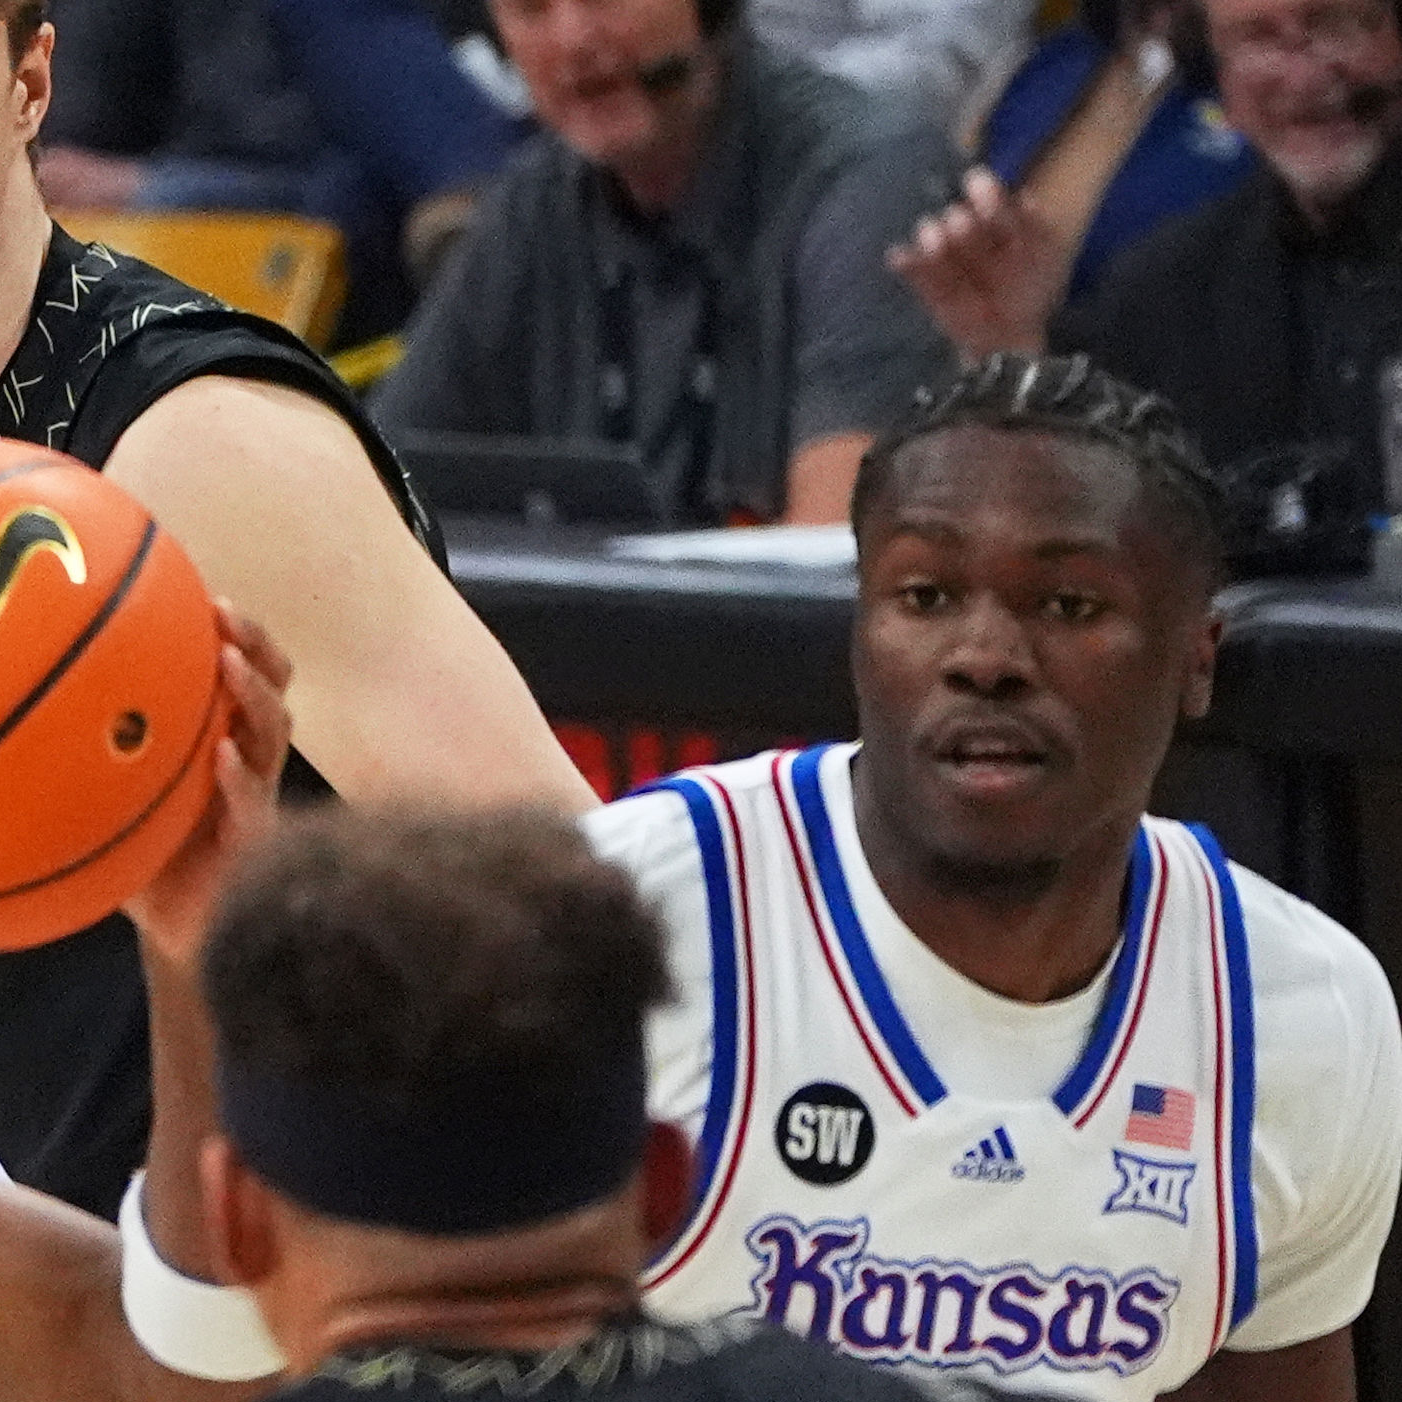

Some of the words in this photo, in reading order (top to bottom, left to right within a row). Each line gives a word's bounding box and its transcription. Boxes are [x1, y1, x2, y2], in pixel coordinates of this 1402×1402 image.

[786, 1102, 864, 1167] SW
[951, 1158, 1026, 1184] adidas
[747, 1215, 1181, 1375] Kansas
